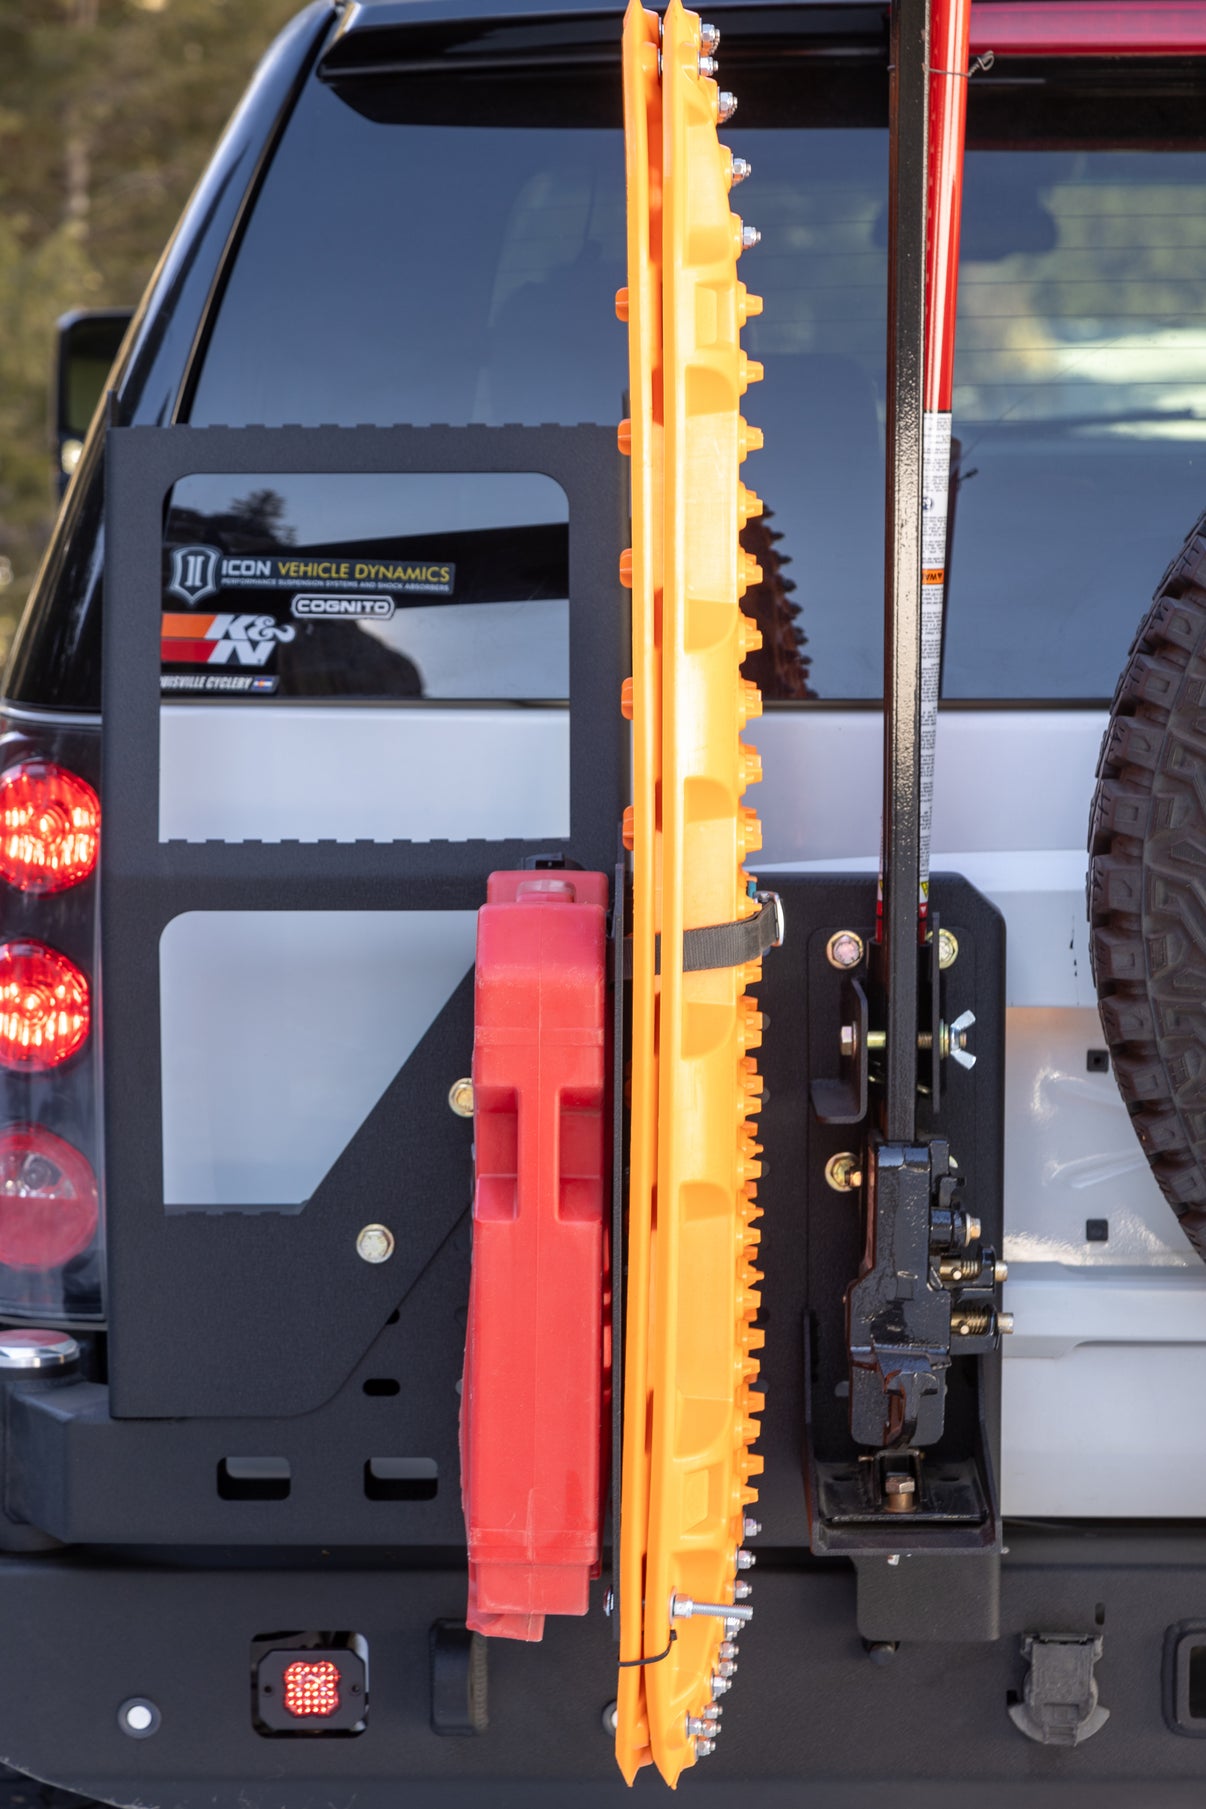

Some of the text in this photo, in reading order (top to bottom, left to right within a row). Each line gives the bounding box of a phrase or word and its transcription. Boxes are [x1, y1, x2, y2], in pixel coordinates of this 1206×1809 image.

[221, 559, 450, 582] ICON VEHICLE DYNAMICS
[221, 577, 450, 592] PERFORMANCE SUSPENSION SYSTEMS AND SHOCK ABSORBERS
[296, 599, 390, 614] COGNITO
[160, 675, 253, 690] UISVILLE CYCLERY
